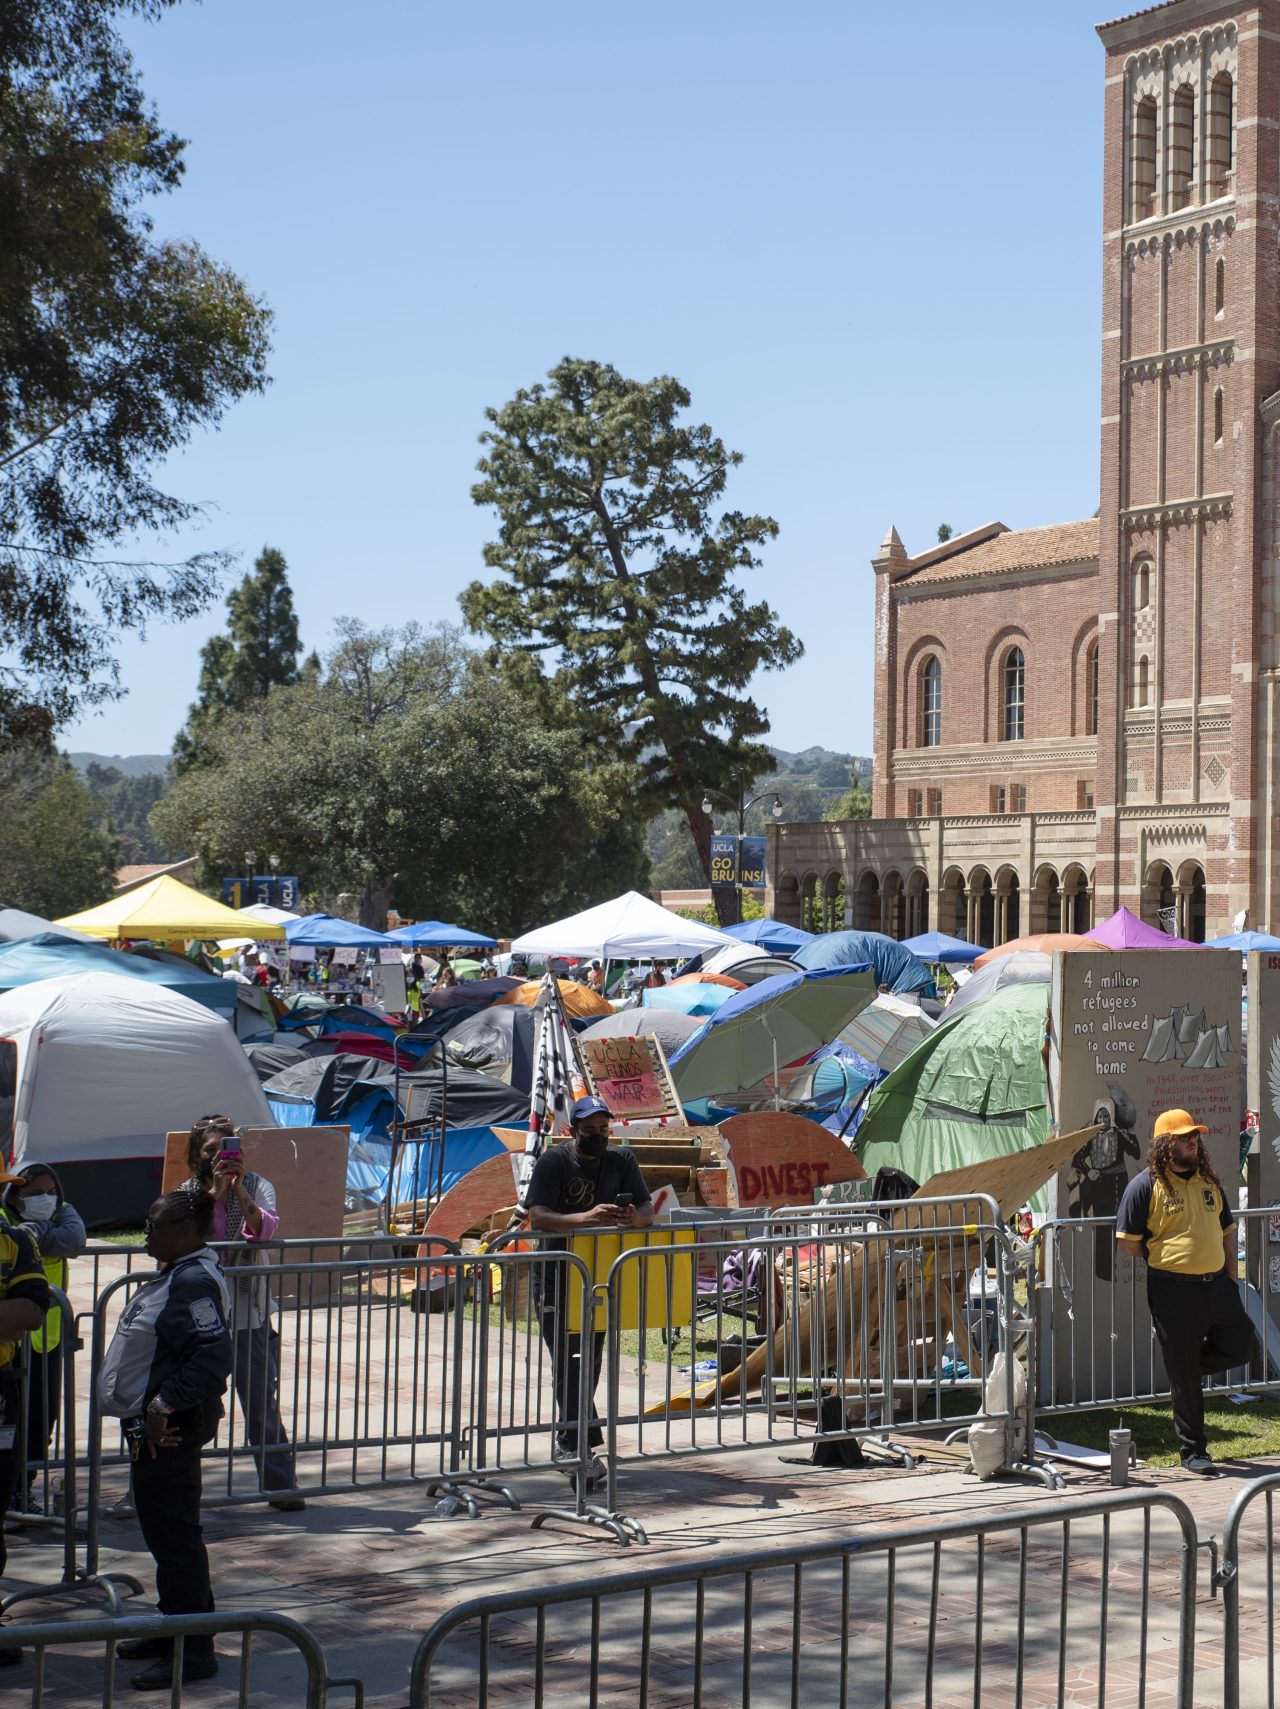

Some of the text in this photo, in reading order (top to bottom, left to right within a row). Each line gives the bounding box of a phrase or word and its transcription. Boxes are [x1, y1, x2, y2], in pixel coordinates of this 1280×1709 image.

[713, 844, 734, 852] UCLA
[712, 857, 732, 869] GO
[712, 870, 735, 881] BRU
[258, 883, 269, 905] CLA
[282, 880, 293, 907] UCLA
[1083, 969, 1141, 989] 4 million
[1082, 990, 1137, 1013] refugees
[1074, 1014, 1149, 1035] not allowed
[593, 1045, 642, 1063] UCLA
[1087, 1040, 1136, 1053] to come
[605, 1062, 642, 1078] FUNDS
[1095, 1055, 1127, 1075] home
[1146, 1075, 1153, 1085] In
[1180, 1075, 1198, 1083] over
[604, 1083, 647, 1104] WAR
[1205, 1085, 1226, 1093] were
[1188, 1096, 1208, 1104] from
[1209, 1094, 1229, 1103] their
[1219, 1105, 1232, 1113] the
[739, 1162, 830, 1200] DIVEST
[1166, 1207, 1185, 1216] STAFF
